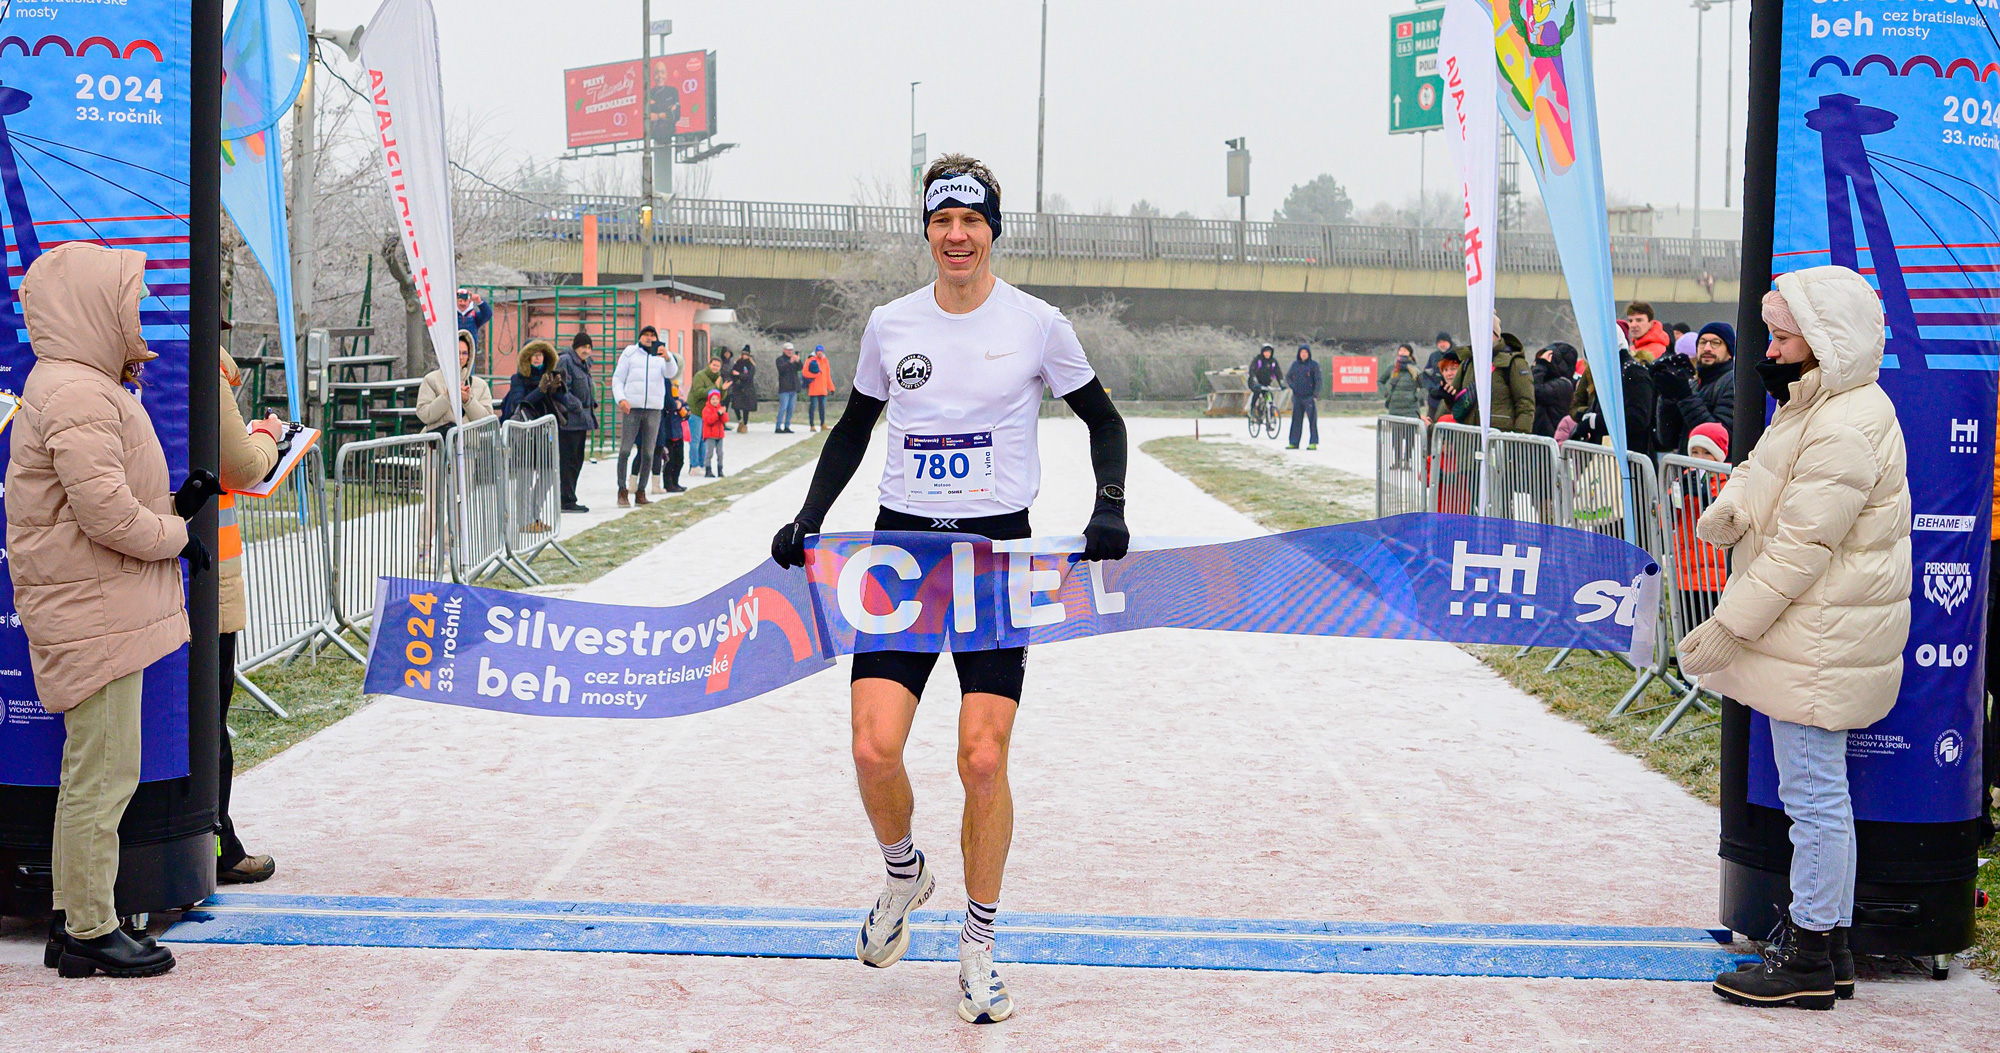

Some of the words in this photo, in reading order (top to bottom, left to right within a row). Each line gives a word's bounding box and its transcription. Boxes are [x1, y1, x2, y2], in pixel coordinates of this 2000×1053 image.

[16, 7, 58, 20] mosty
[1882, 11, 1909, 22] cez
[1913, 9, 1987, 28] bratislavské
[1402, 25, 1408, 35] 2
[1415, 19, 1437, 34] BRNO
[1811, 11, 1873, 38] beh
[1882, 25, 1930, 40] mosty
[1415, 37, 1441, 52] MALAC
[75, 74, 163, 104] 2024
[76, 107, 104, 121] 33.
[108, 107, 162, 125] ročník
[1942, 129, 1966, 145] 33.
[913, 452, 970, 480] 780
[1925, 562, 1971, 575] PERSKINDOL
[440, 596, 463, 661] ročník
[483, 585, 760, 656] Silvestrovský
[404, 592, 438, 691] 2024
[437, 661, 454, 693] 33.
[583, 669, 620, 686] cez
[623, 653, 730, 687] bratislavské
[476, 656, 571, 704] beh
[581, 690, 648, 711] mosty
[1848, 733, 1873, 741] AKULTA
[1885, 742, 1911, 750] ŠPORTU
